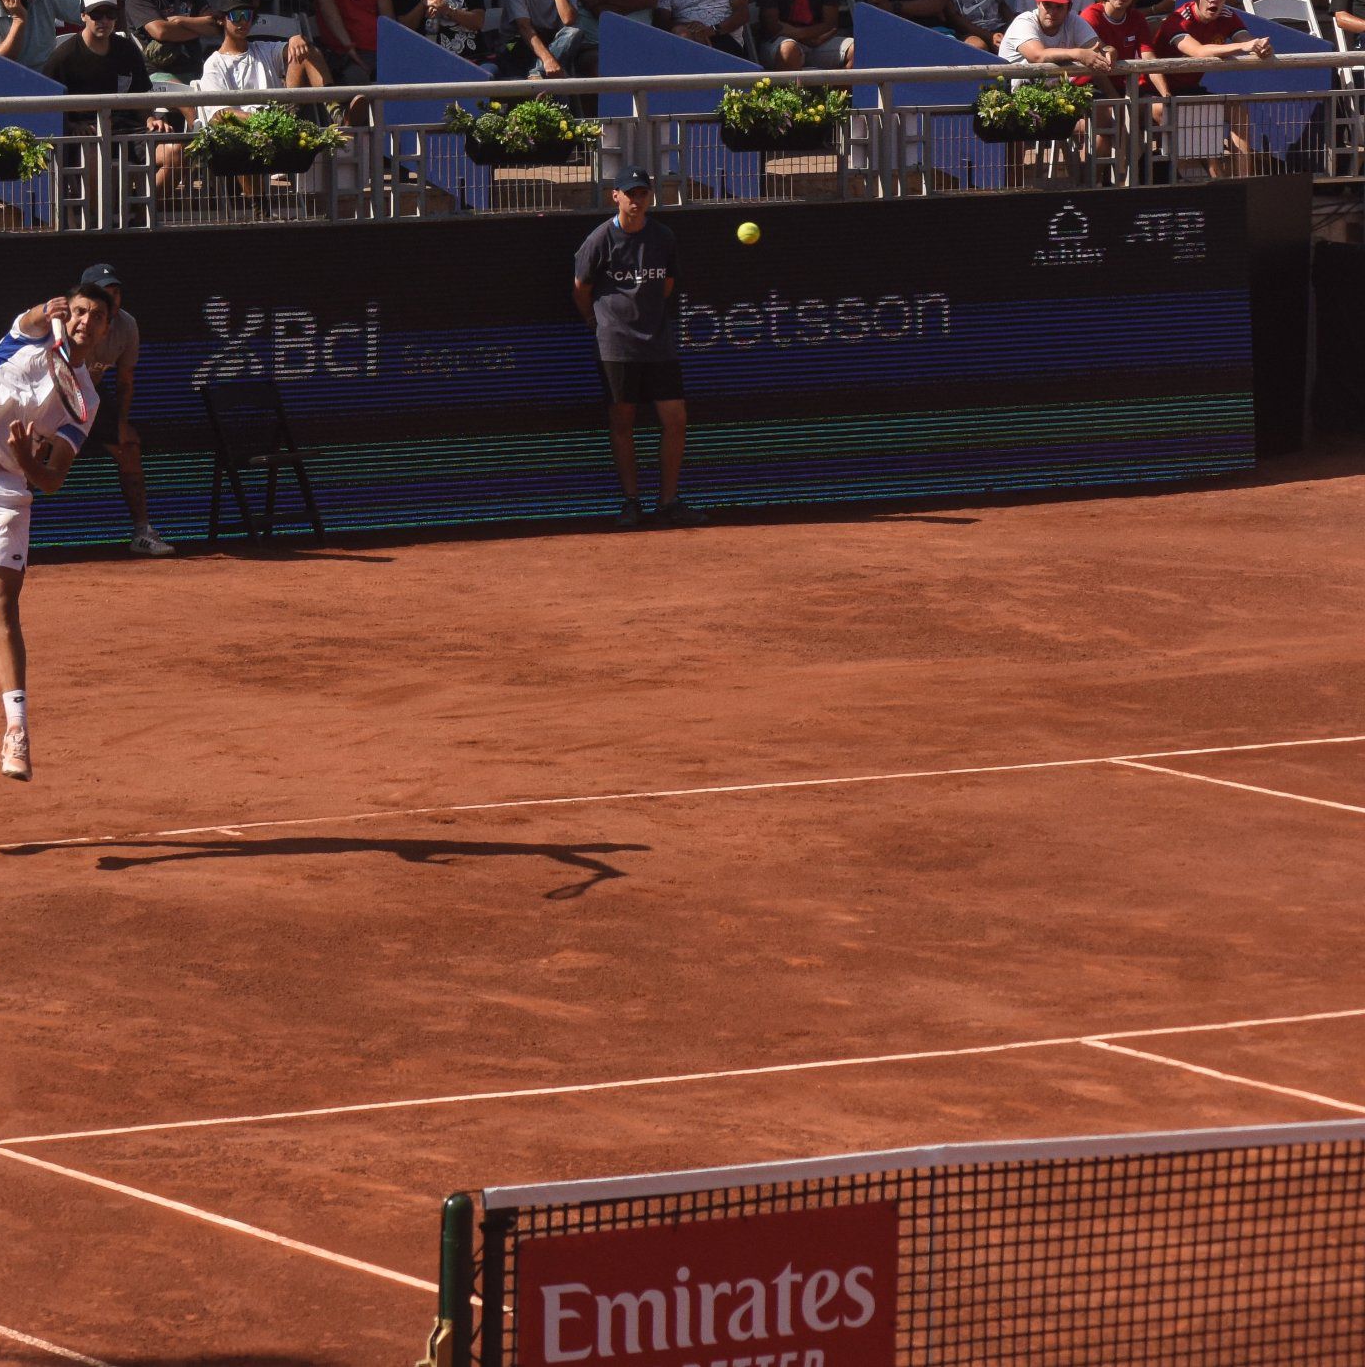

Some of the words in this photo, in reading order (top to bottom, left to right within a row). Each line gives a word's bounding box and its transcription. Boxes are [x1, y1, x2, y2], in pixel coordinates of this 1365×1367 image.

[273, 298, 385, 381] Bci
[677, 289, 951, 352] betsson
[539, 1260, 876, 1364] Emirates
